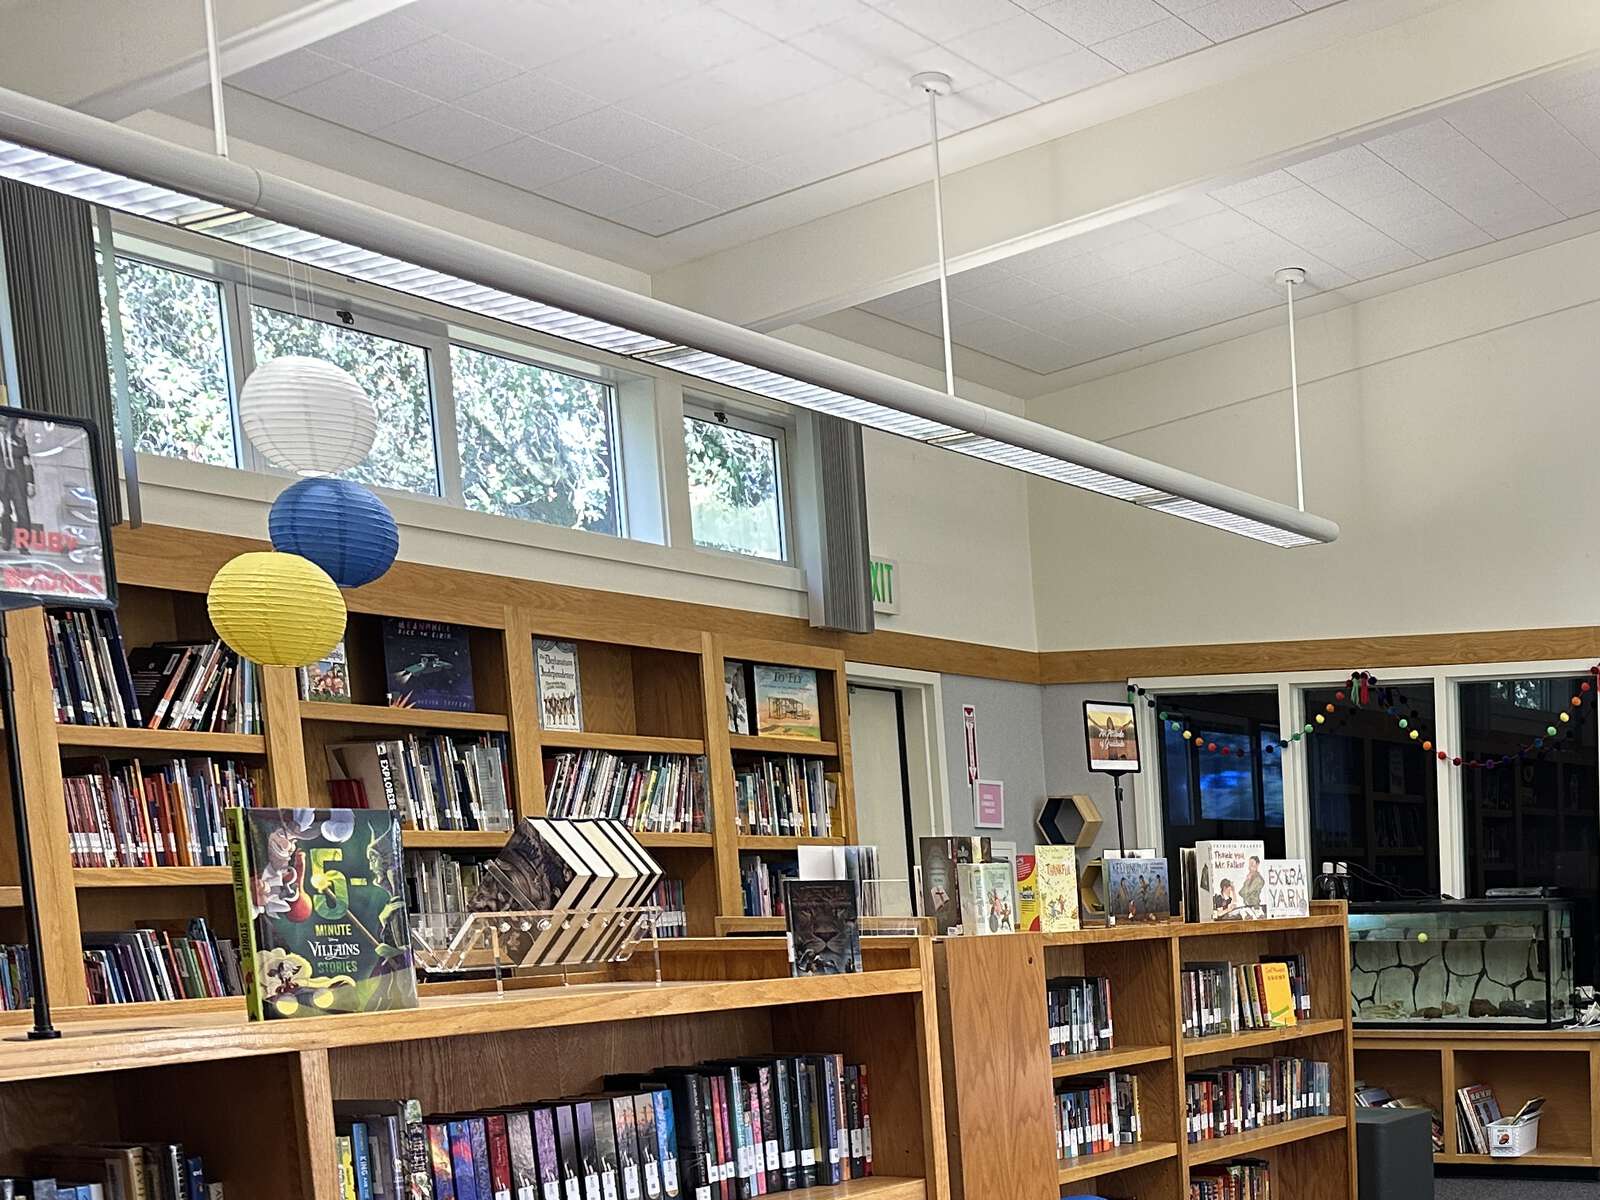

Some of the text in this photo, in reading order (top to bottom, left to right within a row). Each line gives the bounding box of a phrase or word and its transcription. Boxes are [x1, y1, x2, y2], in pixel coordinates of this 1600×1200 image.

[14, 527, 80, 553] RUBY
[869, 560, 893, 605] XIT
[380, 759, 397, 811] EXPLORERS
[1214, 850, 1233, 859] Thank
[1046, 863, 1072, 876] THANKFUL
[1269, 864, 1305, 885] EXTRA
[1269, 888, 1305, 908] YARN
[239, 922, 249, 958] STORIES
[315, 923, 353, 937] MINUTE
[307, 940, 361, 960] VILLAINS
[317, 960, 358, 974] STORIES
[360, 1156, 369, 1175] KING
